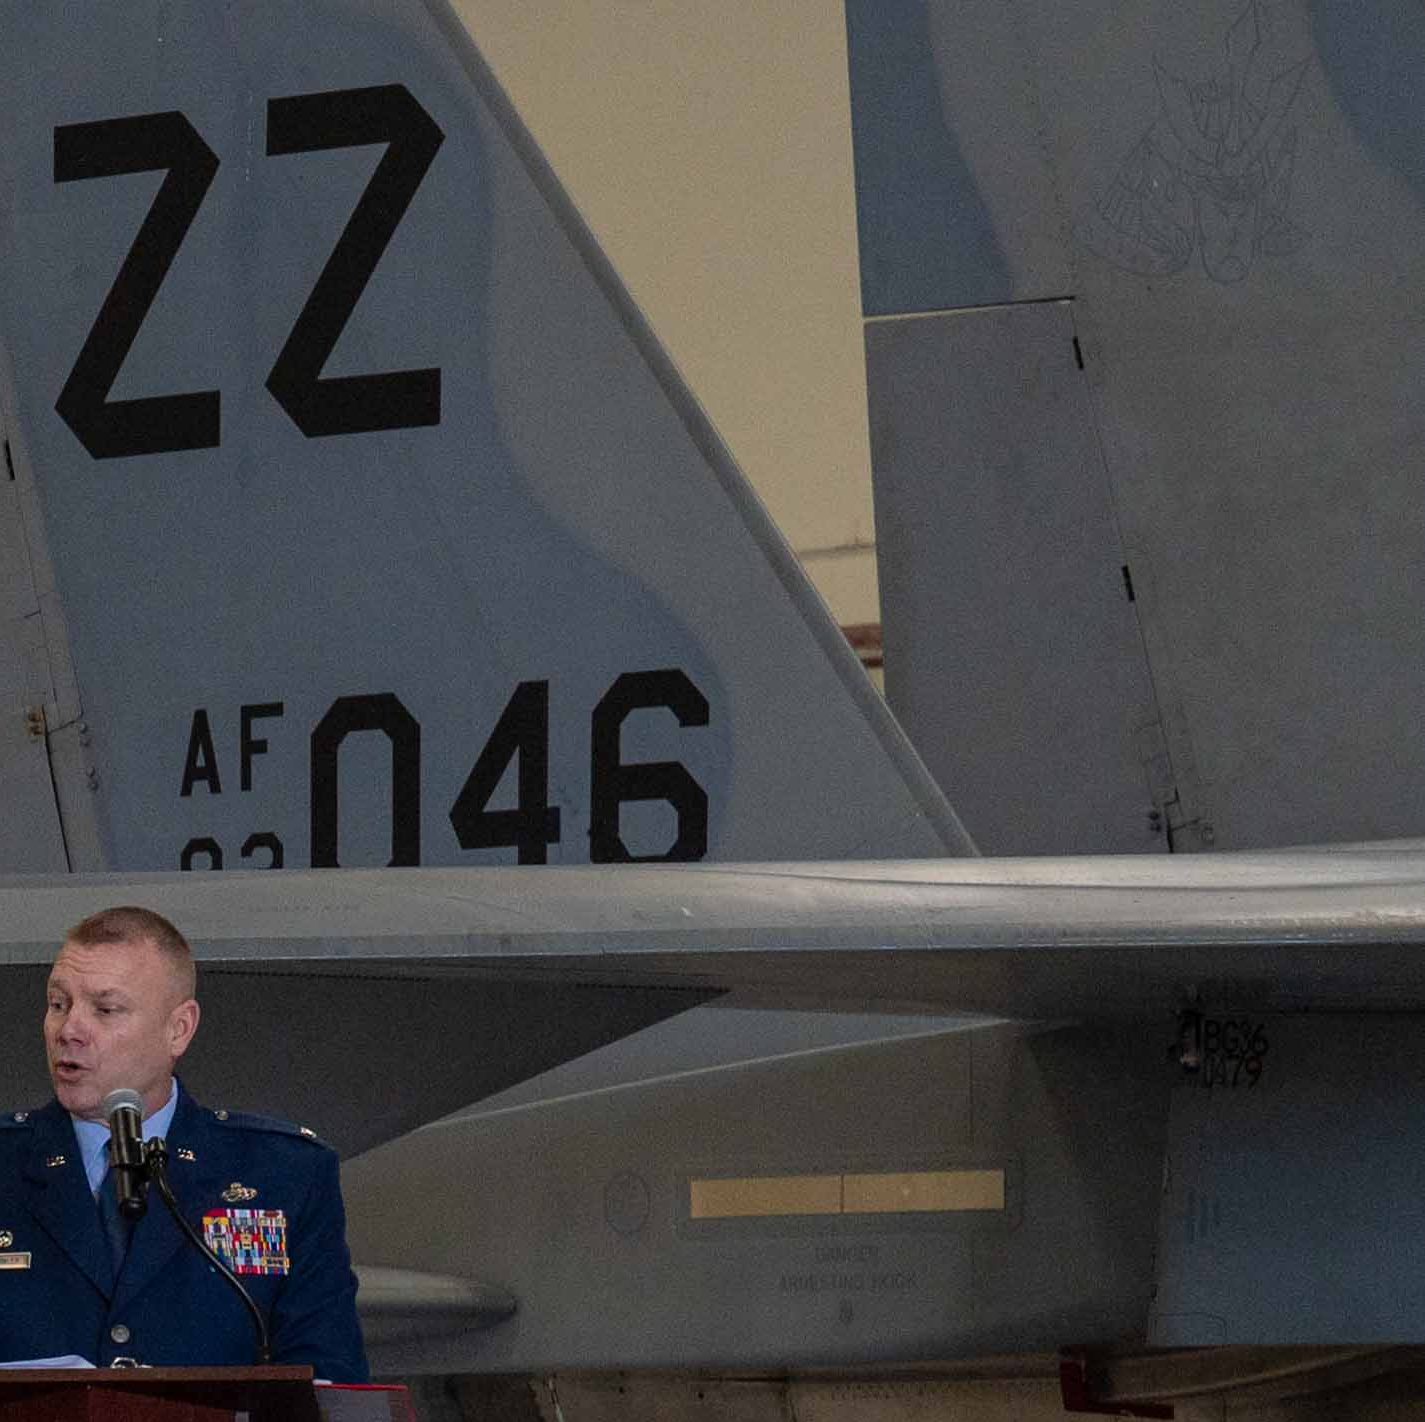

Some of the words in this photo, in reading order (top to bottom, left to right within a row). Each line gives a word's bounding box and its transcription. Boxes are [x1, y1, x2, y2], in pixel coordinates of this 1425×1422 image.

[53, 82, 445, 460] ZZ
[179, 701, 284, 798] AF
[309, 667, 712, 869] 046
